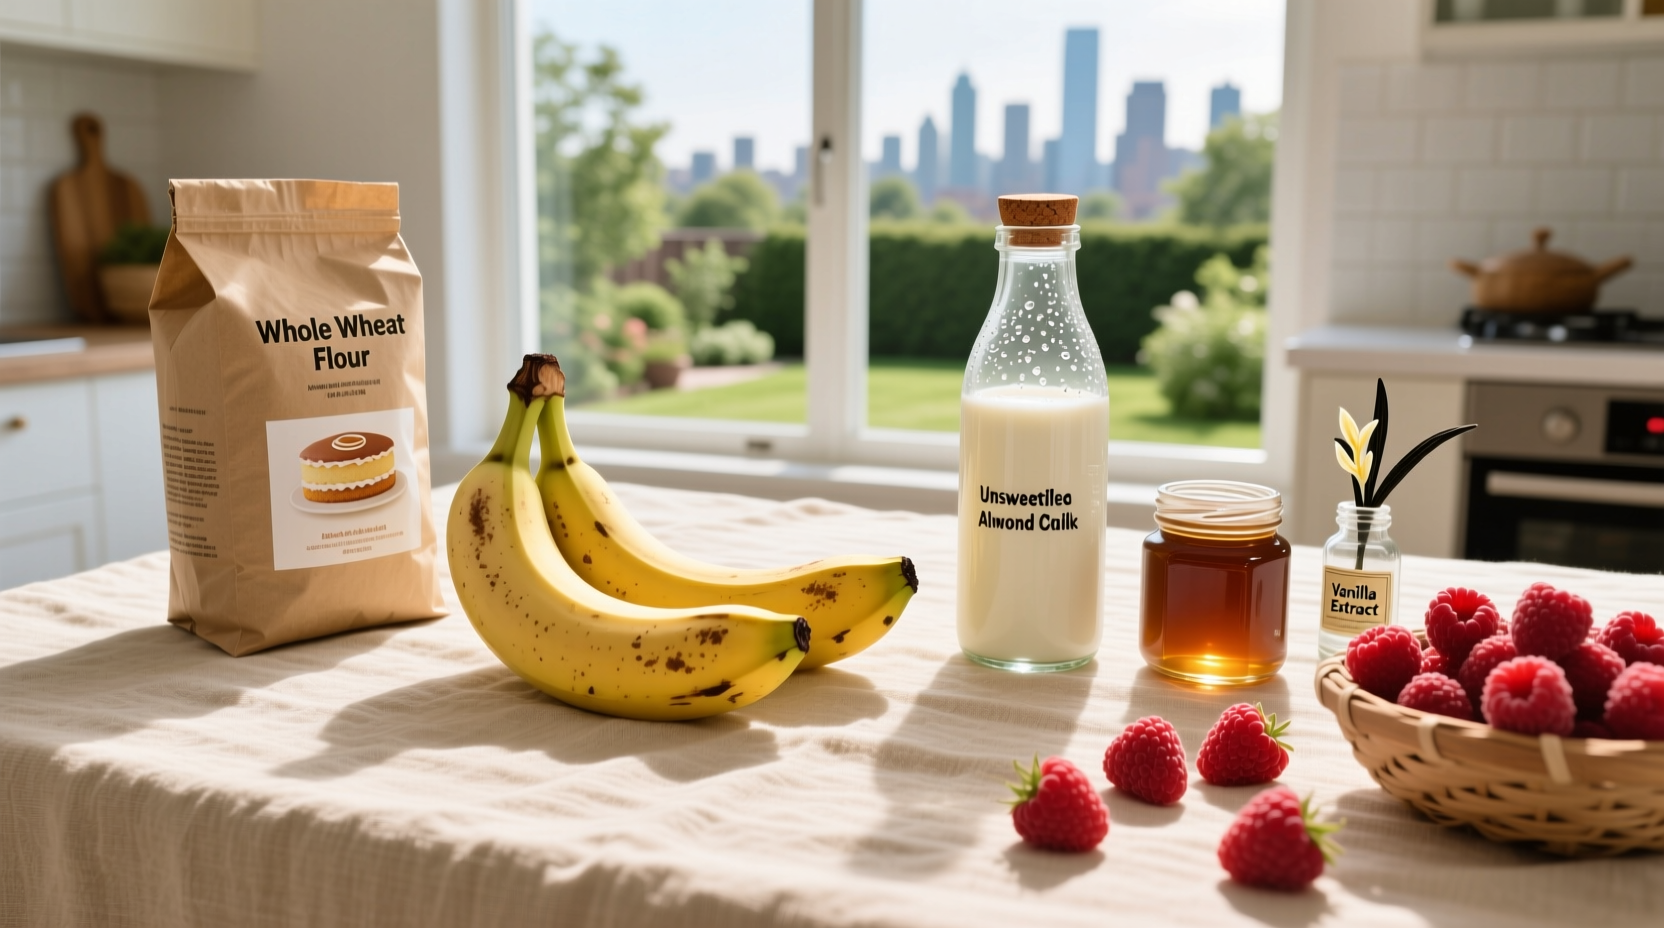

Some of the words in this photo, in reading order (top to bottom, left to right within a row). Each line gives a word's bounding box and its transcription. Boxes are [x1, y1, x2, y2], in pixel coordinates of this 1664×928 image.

[255, 317, 332, 344] Whole
[334, 314, 406, 339] Wheat
[313, 346, 370, 371] Flour
[1331, 582, 1377, 601] Vanilla
